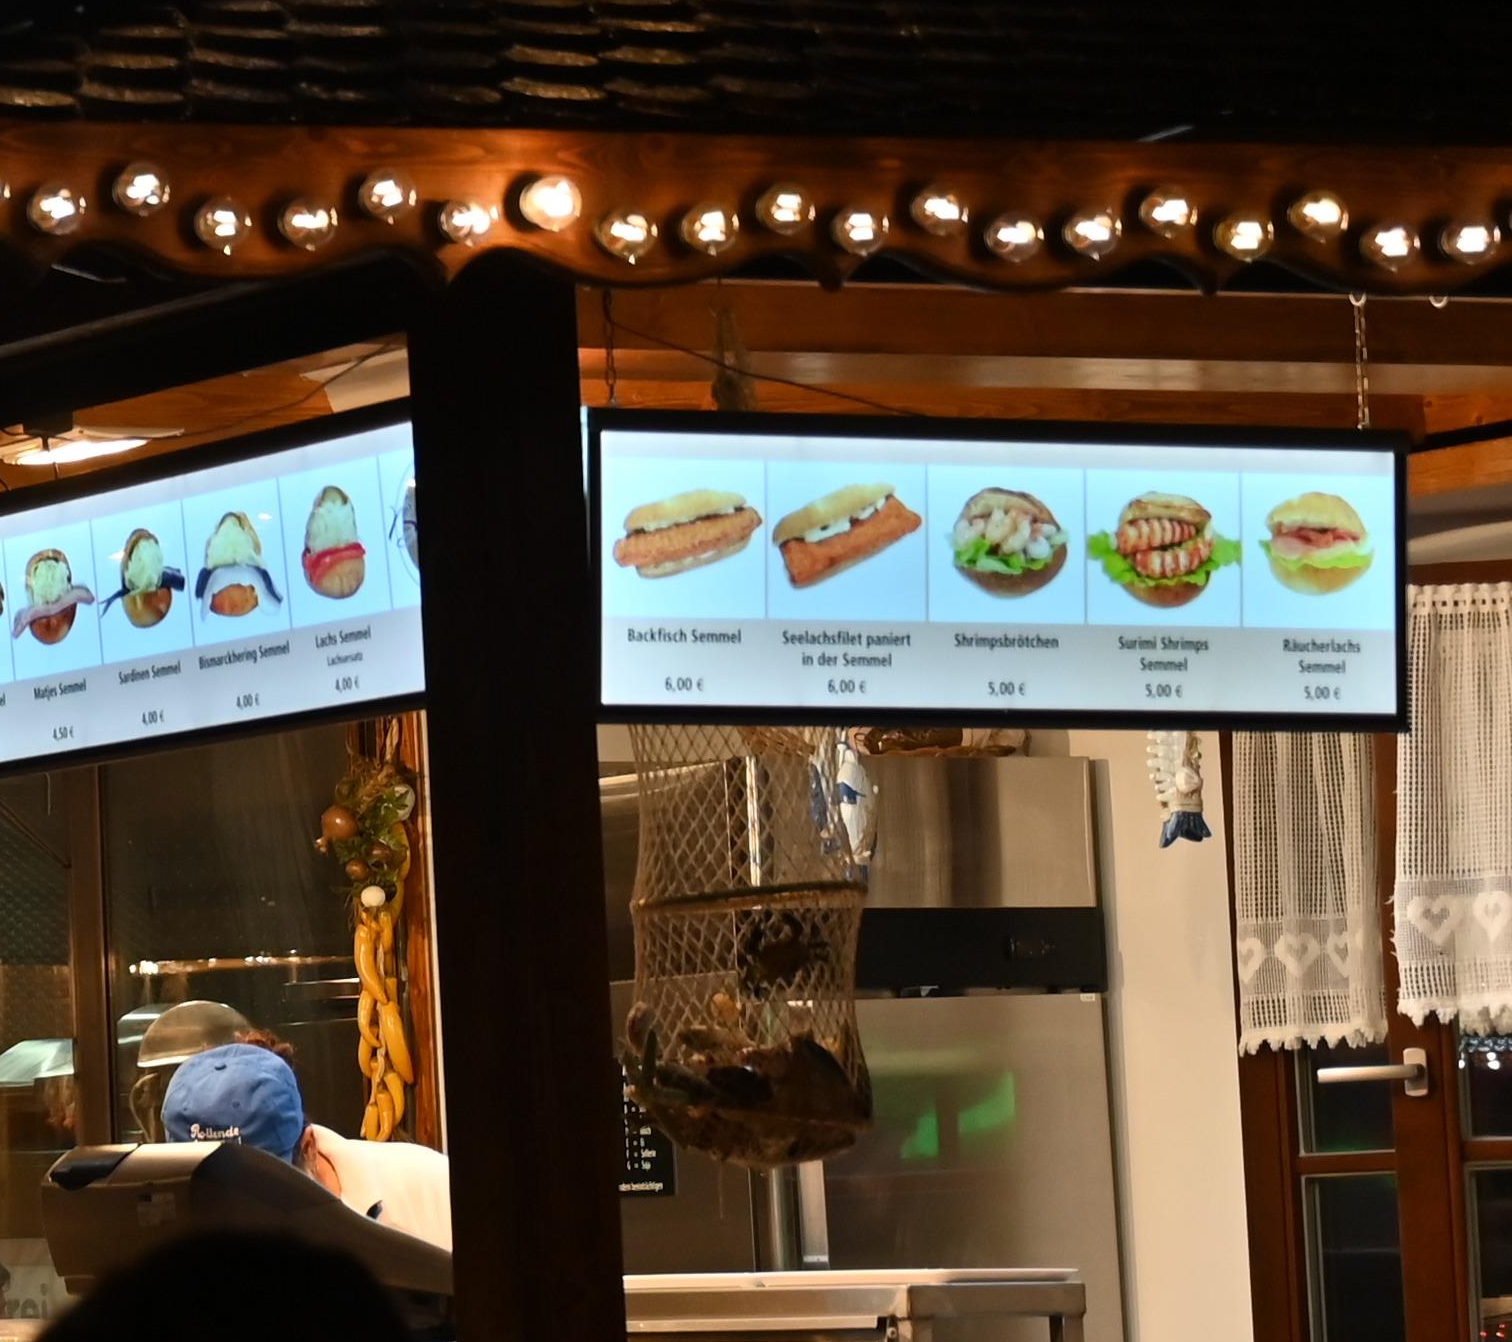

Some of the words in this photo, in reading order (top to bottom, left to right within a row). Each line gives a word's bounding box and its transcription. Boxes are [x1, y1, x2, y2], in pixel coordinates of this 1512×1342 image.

[315, 632, 337, 649] Lachs
[339, 625, 371, 644] Semmel
[628, 629, 687, 643] Backfisch
[691, 630, 742, 643] Semmel
[783, 631, 862, 646] Seelachsfilet
[866, 632, 911, 649] paniert
[954, 633, 1059, 651] Shrimpsbrötchen
[1119, 636, 1157, 650] Surimi
[1161, 637, 1209, 654] Shrimps
[1283, 639, 1360, 653] Räucherlachs
[199, 647, 257, 670] Bismarckhering
[259, 641, 290, 659] Semmel
[802, 653, 813, 666] in
[817, 653, 838, 667] der
[843, 654, 892, 667] Semmel
[1140, 658, 1188, 671] Semmel
[1299, 660, 1346, 673] Semmel
[119, 668, 150, 685] Sardinen
[151, 661, 181, 679] Semmel
[34, 684, 57, 701] Matjes
[59, 679, 86, 696] Semmel
[336, 677, 352, 692] 4,00
[665, 678, 693, 692] 6,00
[696, 679, 704, 691] €
[828, 680, 855, 694] 6,00
[859, 681, 866, 693] €
[988, 682, 1014, 696] 5,00
[1018, 684, 1025, 696] €
[1145, 684, 1171, 698] 5,00
[1175, 685, 1182, 698] €
[1304, 686, 1329, 700] 5,00
[1333, 687, 1340, 700] €
[236, 694, 253, 709] 4,00
[142, 710, 157, 726] 4,00
